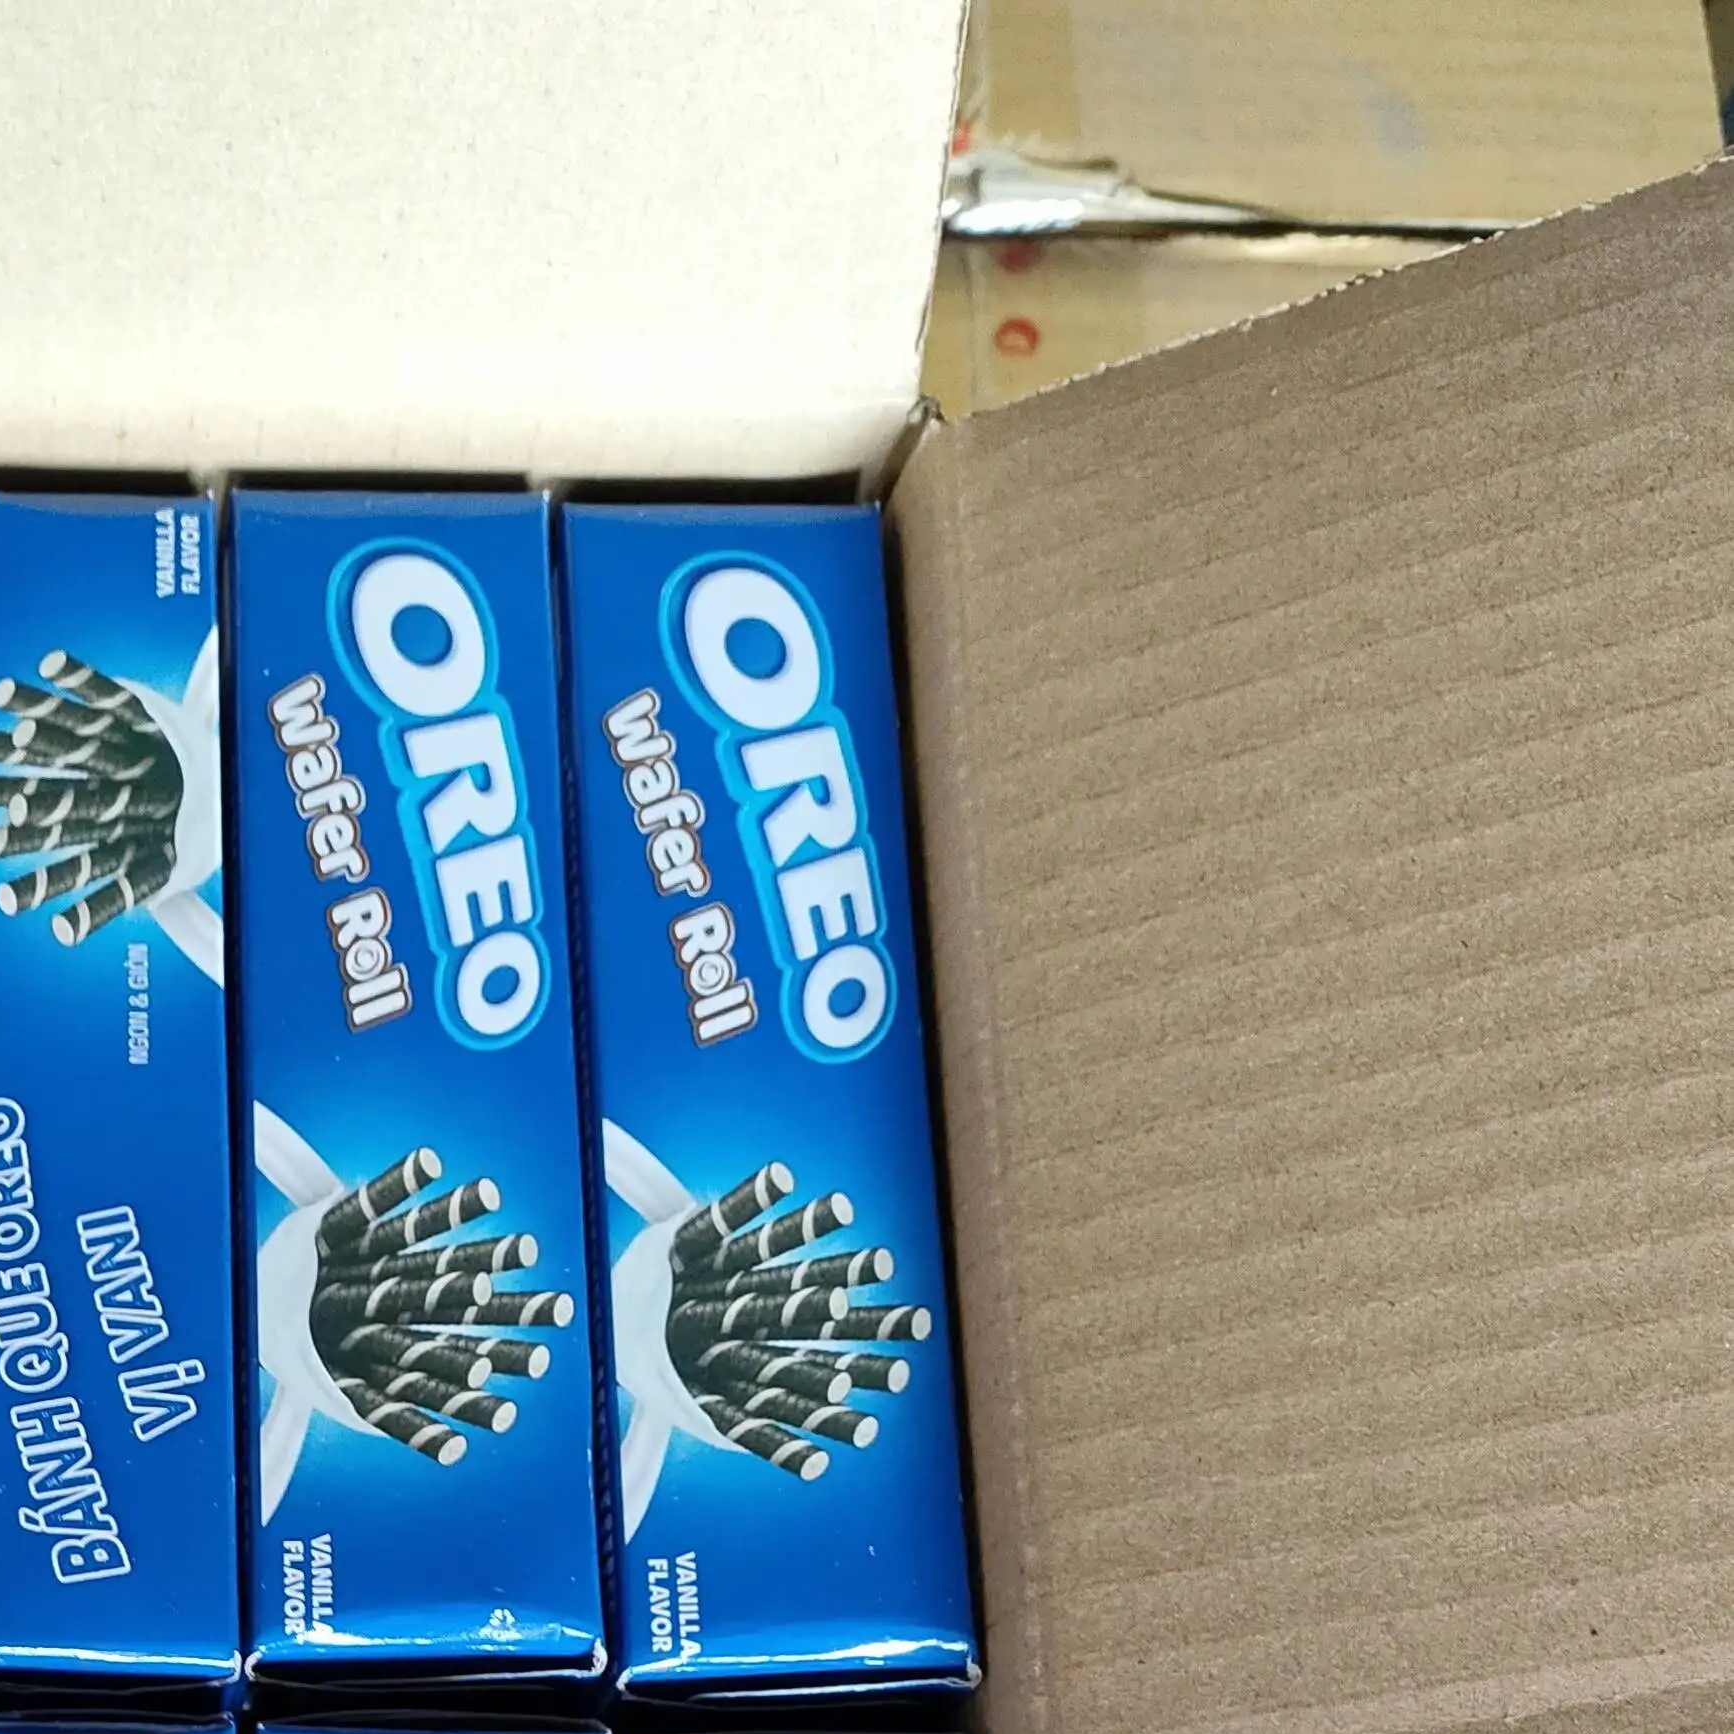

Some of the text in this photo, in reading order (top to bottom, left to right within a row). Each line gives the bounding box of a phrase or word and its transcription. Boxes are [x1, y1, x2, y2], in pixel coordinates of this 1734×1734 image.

[154, 507, 175, 598] VANILLA
[180, 513, 201, 595] FLAVOR
[267, 672, 414, 1033] Wafer Roll
[349, 551, 542, 1038] OREO
[602, 687, 760, 1048] Wafer Roll
[683, 566, 887, 1050] OREO
[76, 1205, 206, 1442] VỊ VANI
[10, 1396, 132, 1584] BÁNH
[282, 1540, 306, 1636] FLAVOR
[310, 1533, 334, 1640] VANILLA
[647, 1558, 673, 1653] FLAVOR
[675, 1551, 702, 1664] VANILLA
